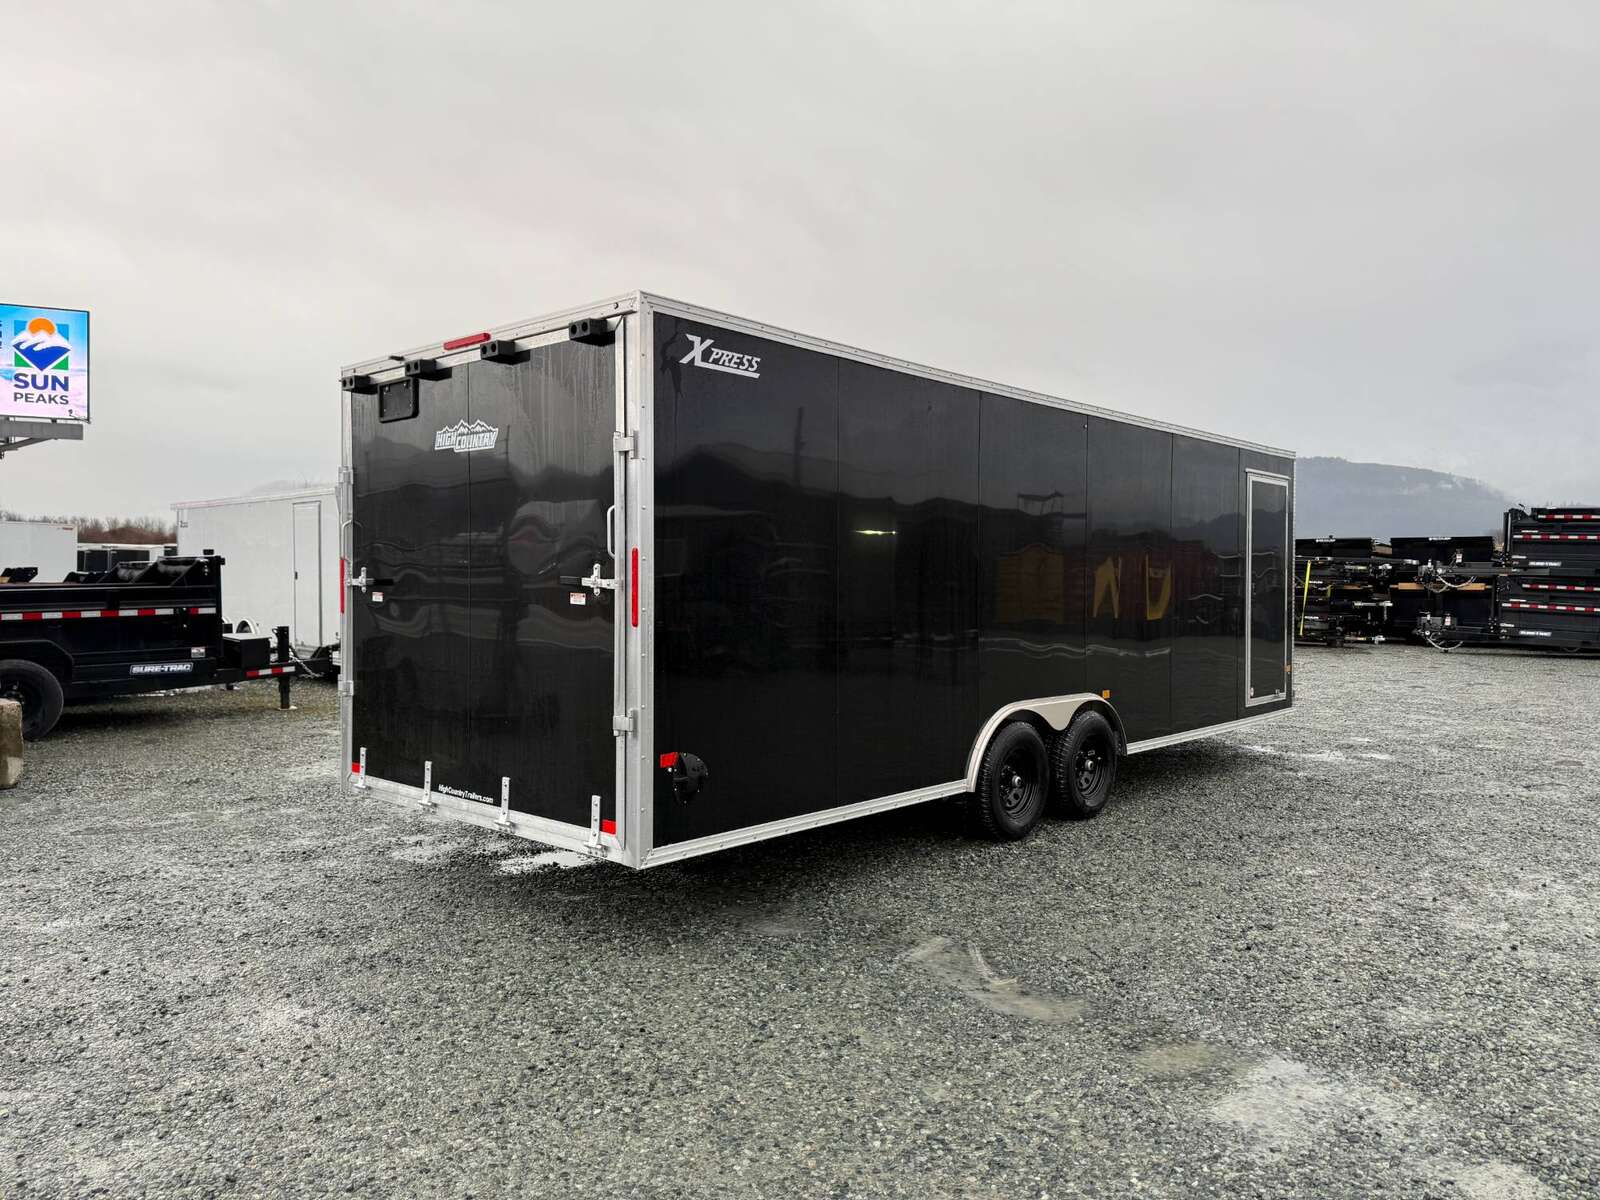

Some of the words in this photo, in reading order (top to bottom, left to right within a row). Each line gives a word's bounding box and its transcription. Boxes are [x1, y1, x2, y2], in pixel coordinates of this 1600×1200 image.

[679, 334, 761, 372] XPRESS
[13, 373, 69, 391] SUN
[13, 392, 69, 405] PEAKS
[435, 432, 456, 446] HIGH
[455, 432, 496, 449] COUNTRY
[132, 664, 191, 673] SURE-TRAC
